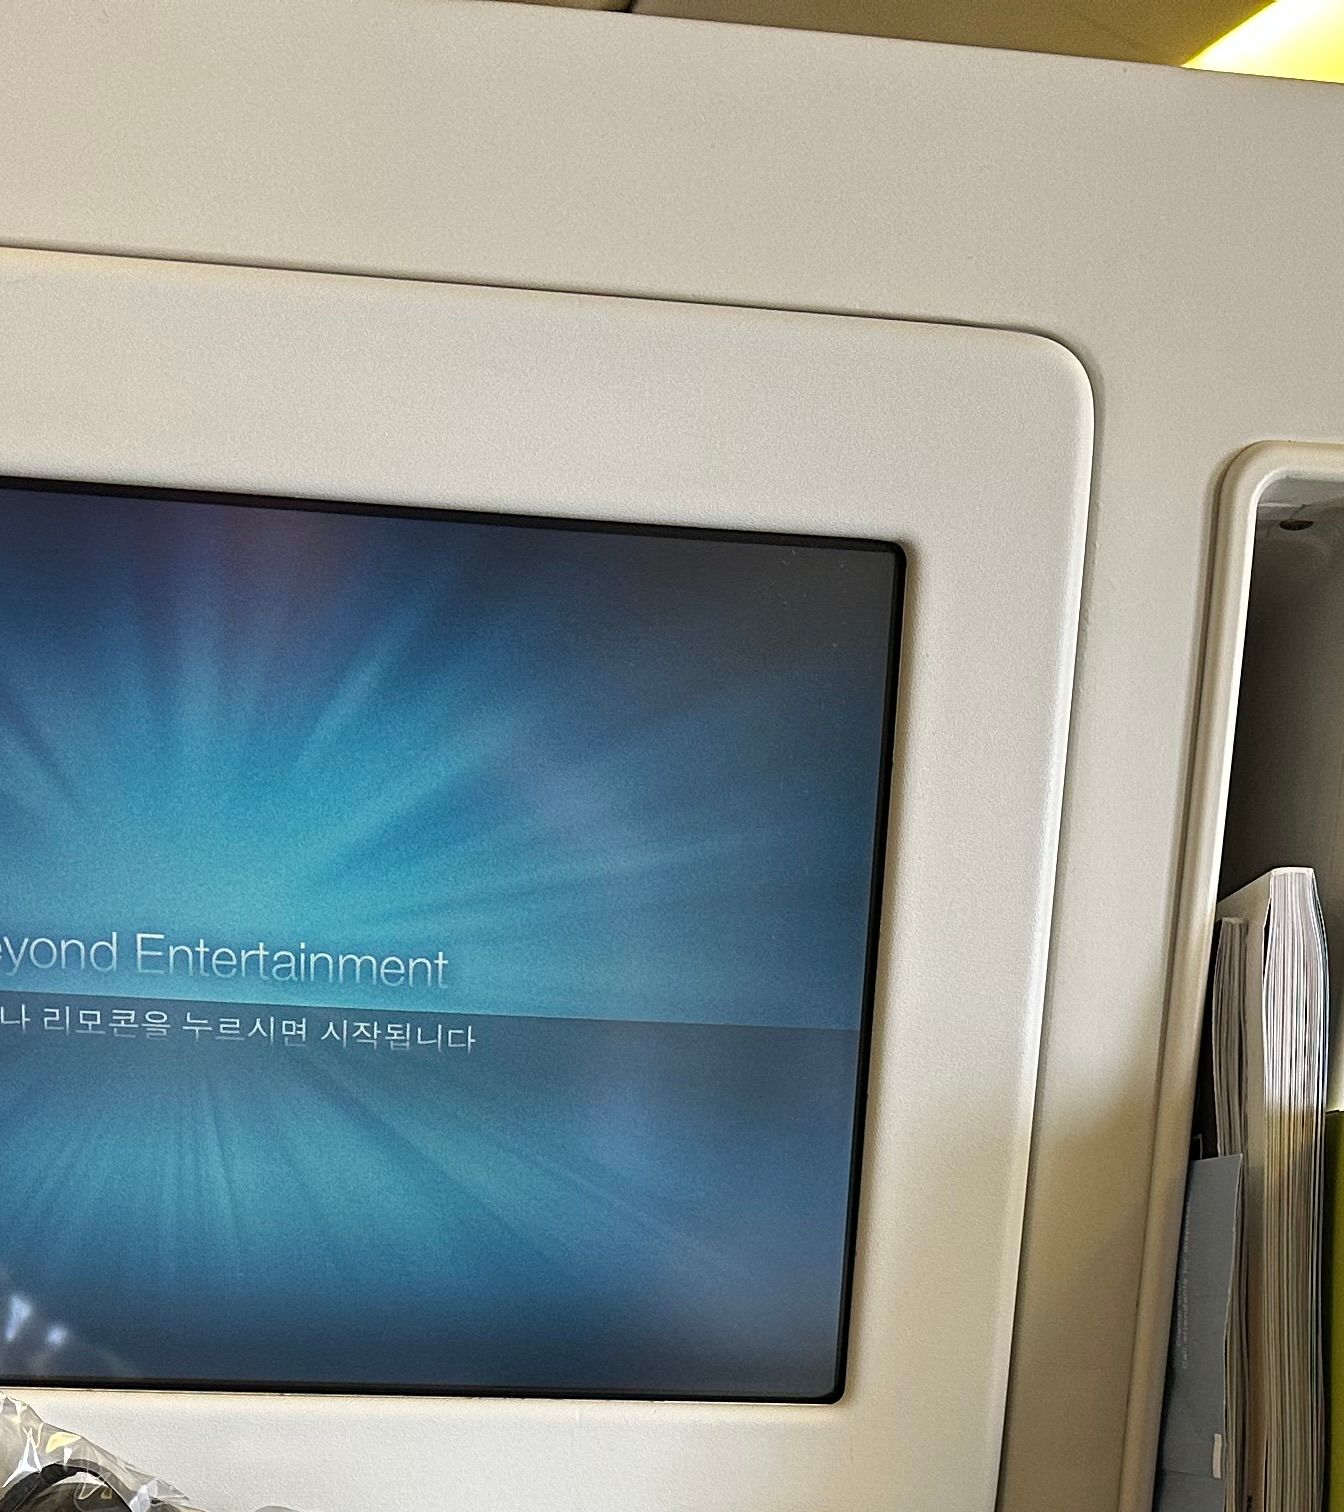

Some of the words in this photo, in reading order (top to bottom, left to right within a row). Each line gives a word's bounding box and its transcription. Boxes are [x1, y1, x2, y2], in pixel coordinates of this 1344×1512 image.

[135, 933, 449, 989] Entertainment
[43, 1005, 171, 1039] 리모콘을
[182, 1013, 308, 1047] 누르시면
[322, 1020, 476, 1055] 시작됩니다
